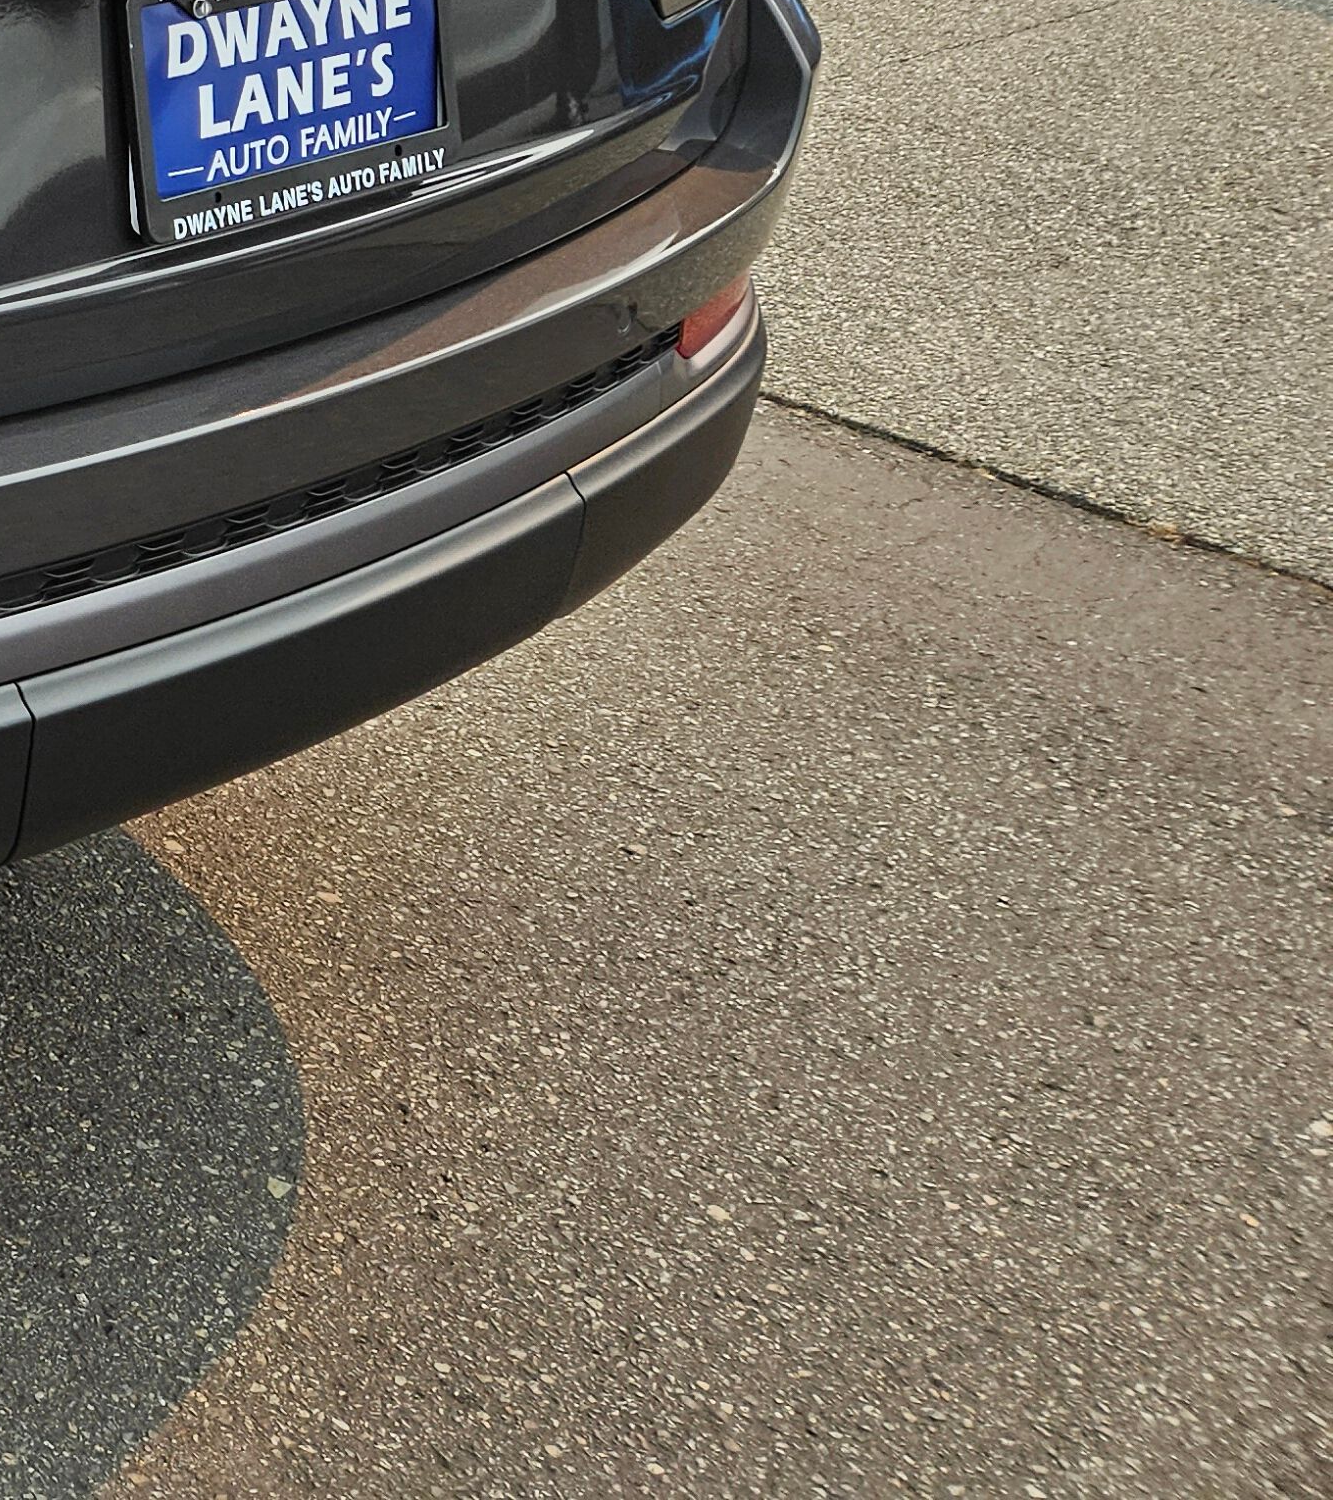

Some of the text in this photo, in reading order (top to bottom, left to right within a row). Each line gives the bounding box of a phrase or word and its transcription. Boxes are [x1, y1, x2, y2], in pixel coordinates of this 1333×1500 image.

[199, 42, 394, 140] LANE'S
[206, 106, 393, 182] AUTO FAMILY
[173, 147, 446, 241] DWAYNE LANE'S AUTO FAMILY
